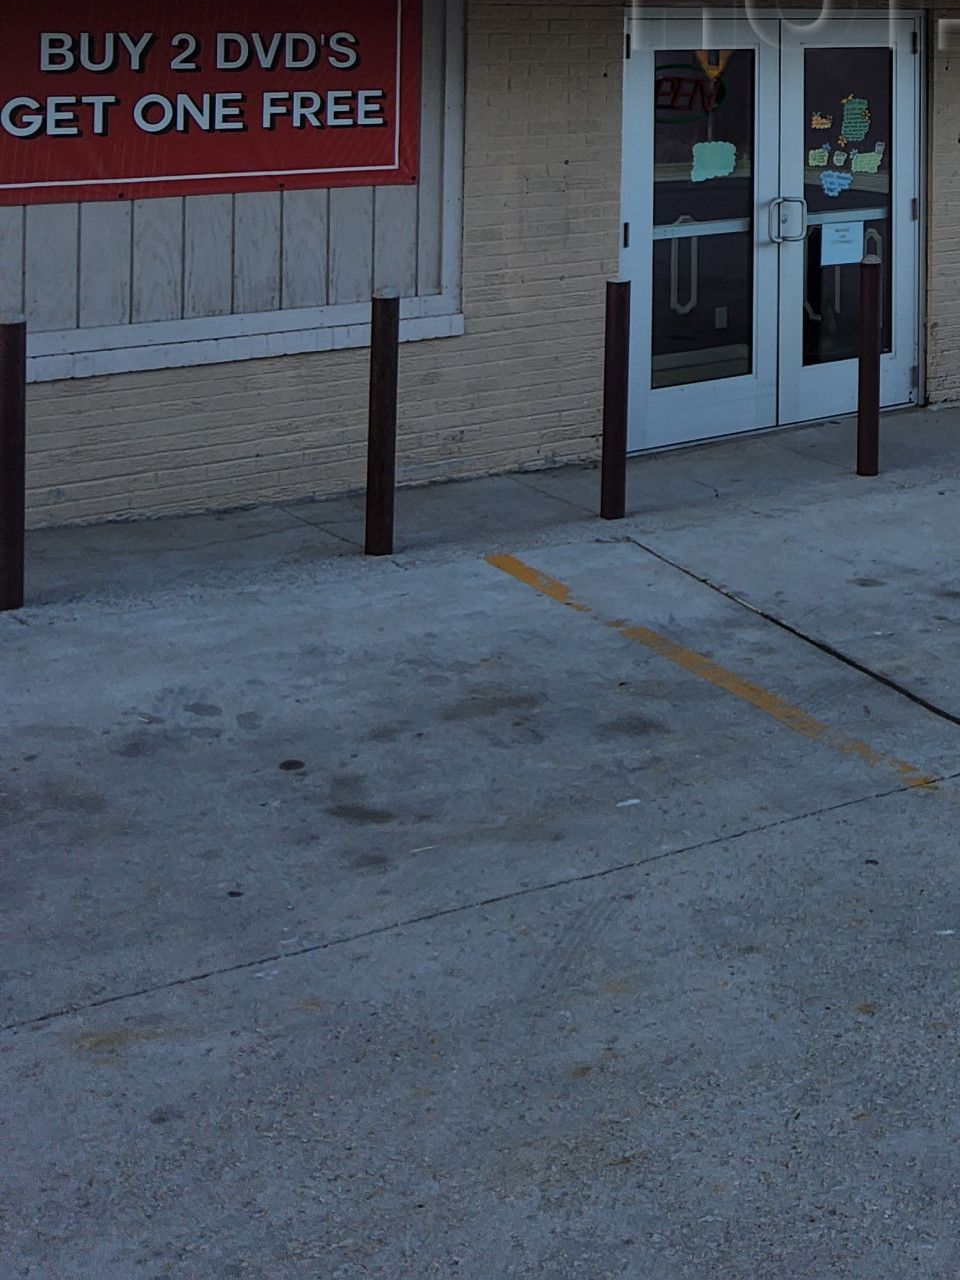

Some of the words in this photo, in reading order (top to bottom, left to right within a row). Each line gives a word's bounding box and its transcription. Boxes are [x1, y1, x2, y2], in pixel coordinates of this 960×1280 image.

[39, 31, 154, 72] BUY
[169, 33, 198, 71] 2
[215, 31, 359, 70] DVD'S
[0, 94, 117, 138] GET
[132, 92, 245, 133] ONE
[261, 89, 385, 129] FREE
